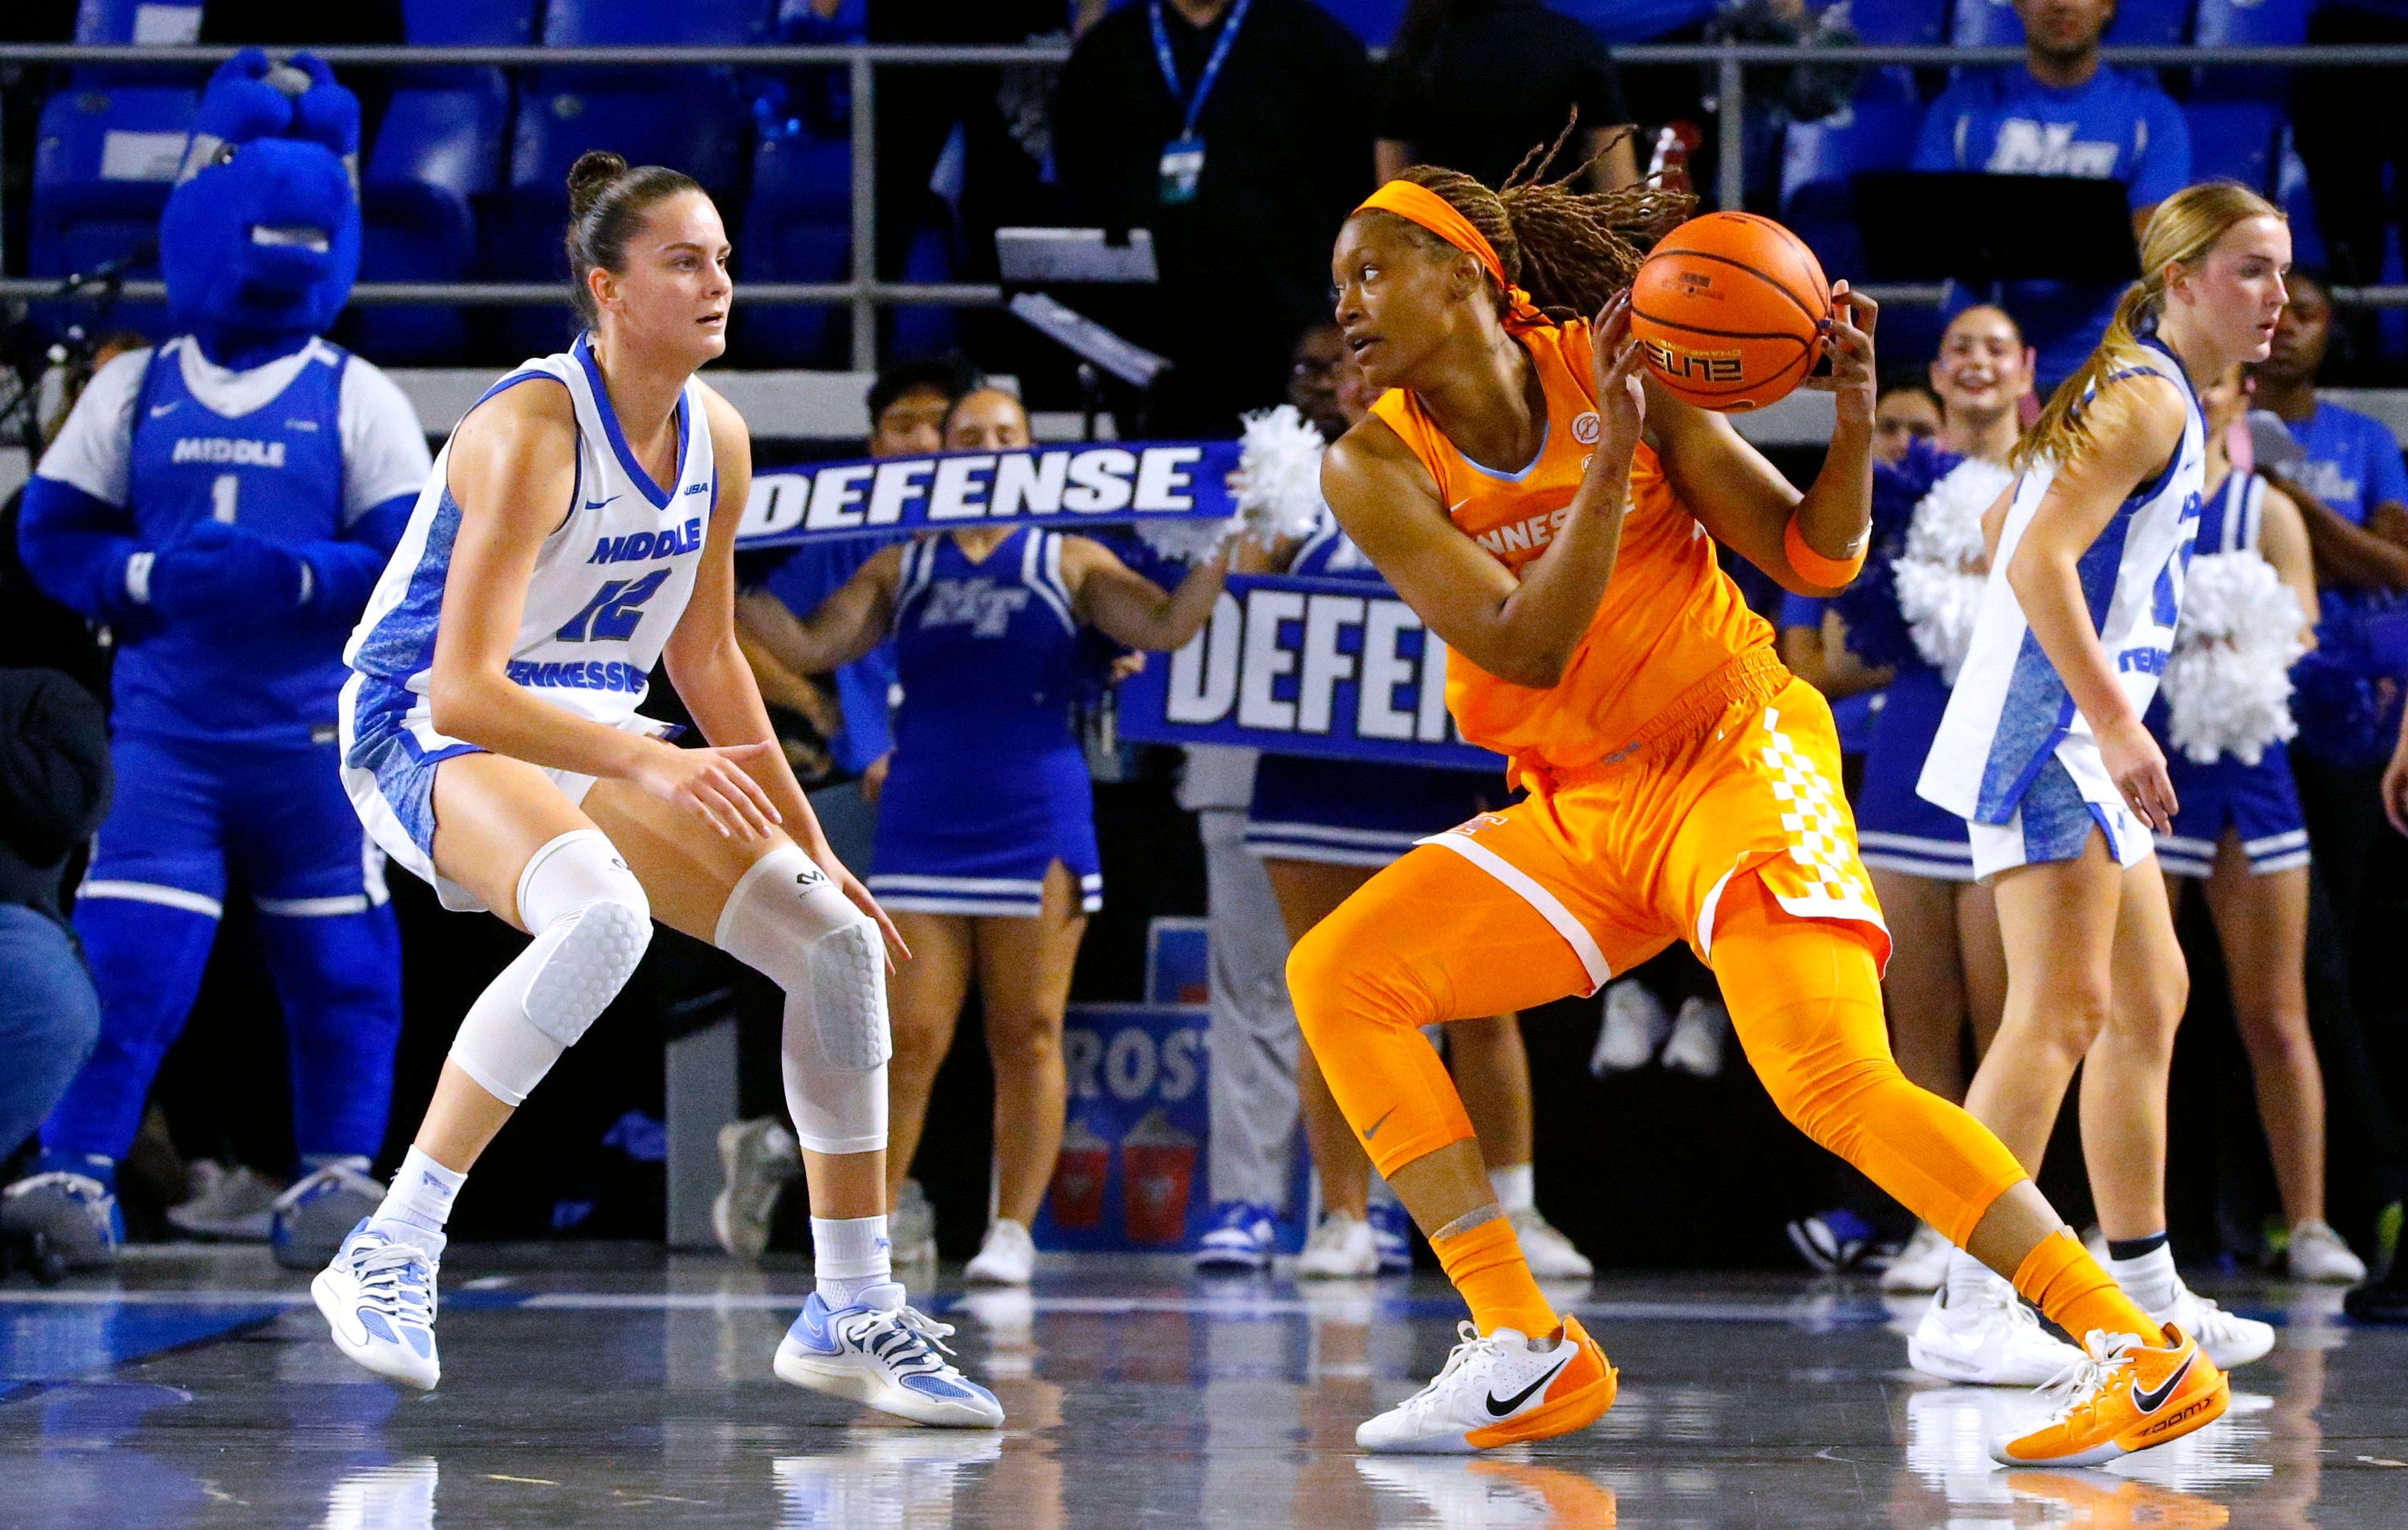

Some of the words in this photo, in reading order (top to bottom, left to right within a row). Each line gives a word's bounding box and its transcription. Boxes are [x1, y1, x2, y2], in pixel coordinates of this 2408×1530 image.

[1645, 340, 1743, 382] ELITE
[172, 437, 286, 467] MIDDLE
[734, 447, 1202, 539] DEFENSE
[586, 517, 701, 564] MIDDLE
[555, 567, 673, 642] 12
[918, 578, 1031, 639] MT
[1064, 1027, 1214, 1101] ROS
